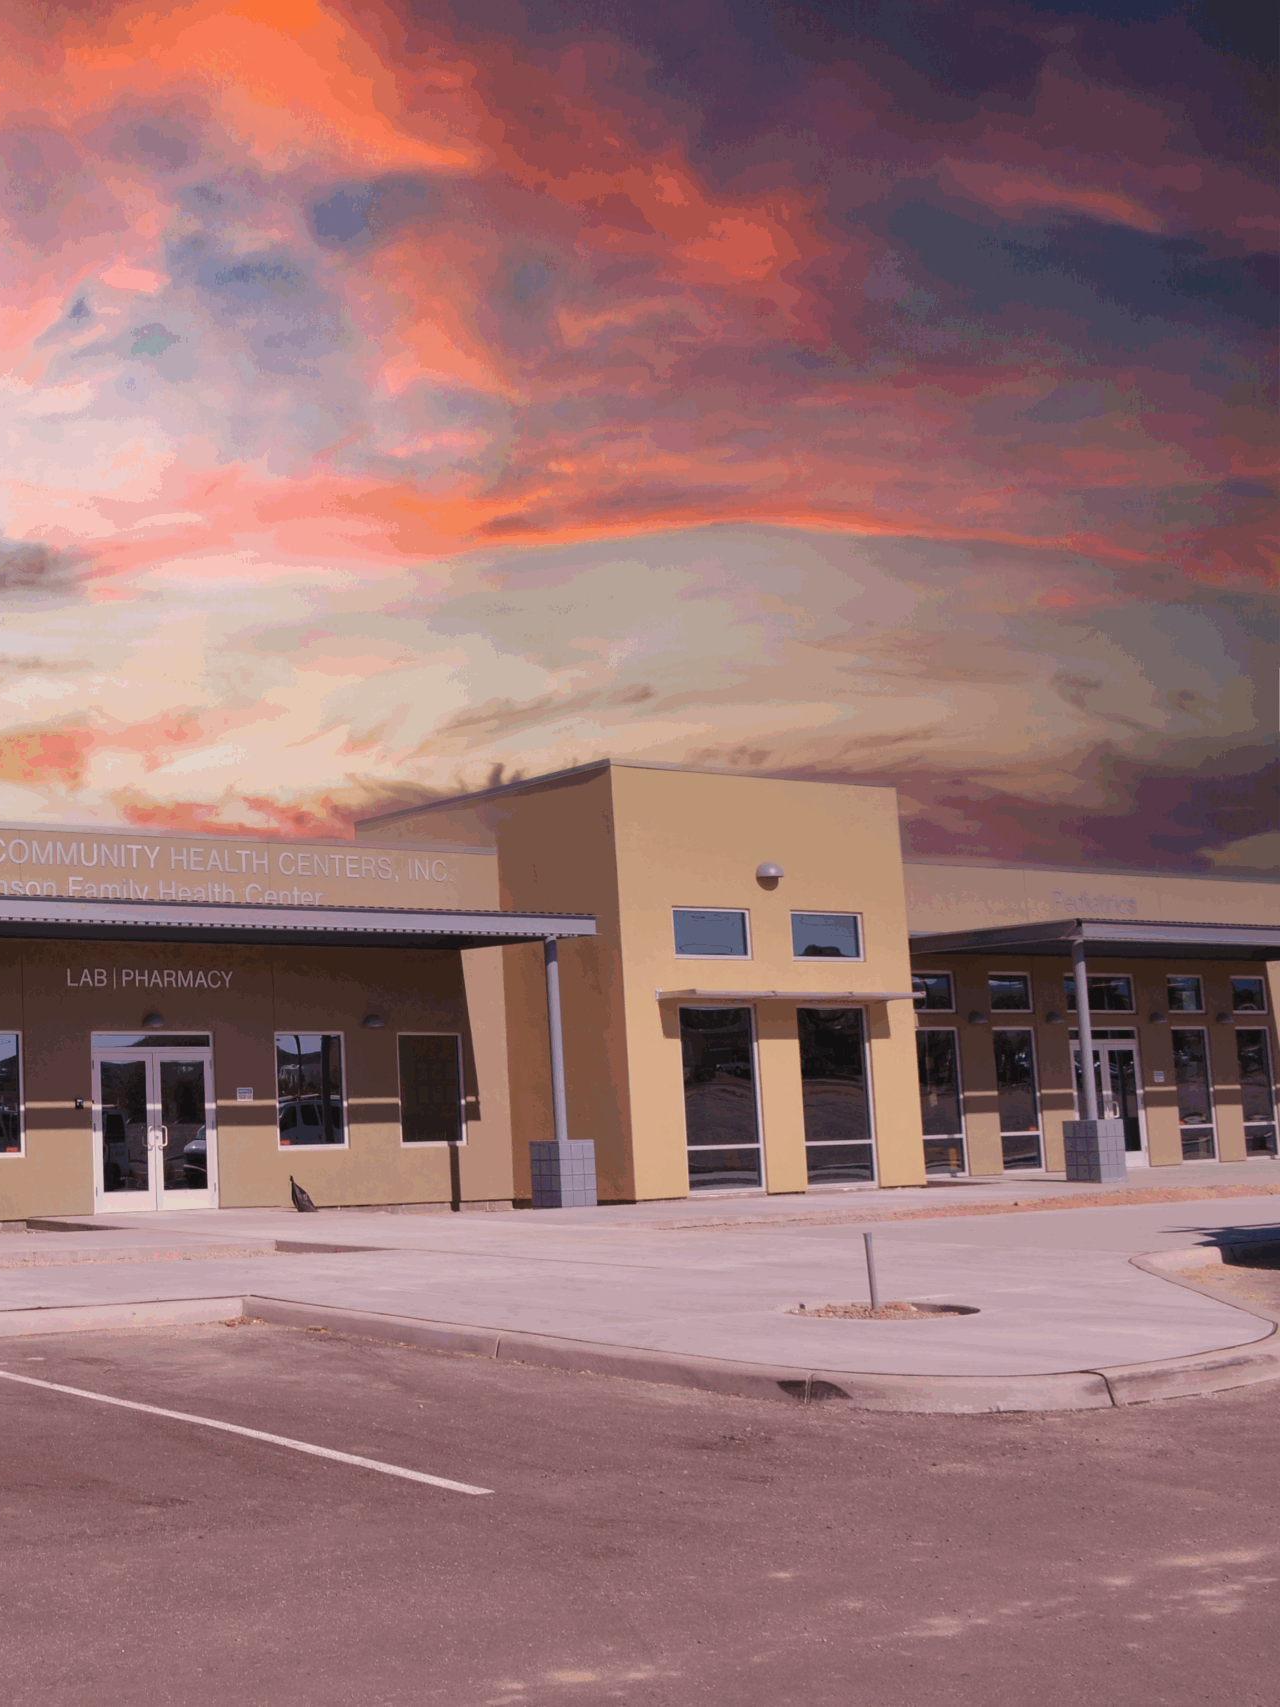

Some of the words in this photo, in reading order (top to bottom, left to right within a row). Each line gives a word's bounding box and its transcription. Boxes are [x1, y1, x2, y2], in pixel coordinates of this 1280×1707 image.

[170, 847, 269, 874] HEALTH
[278, 852, 400, 883] CENTERS,
[408, 858, 454, 882] INC.
[68, 877, 149, 899] Family
[158, 880, 235, 902] Health
[245, 884, 324, 905] Center
[1052, 888, 1138, 915] Pediatrics
[66, 968, 107, 987] LAB
[122, 968, 233, 988] PHARMACY
